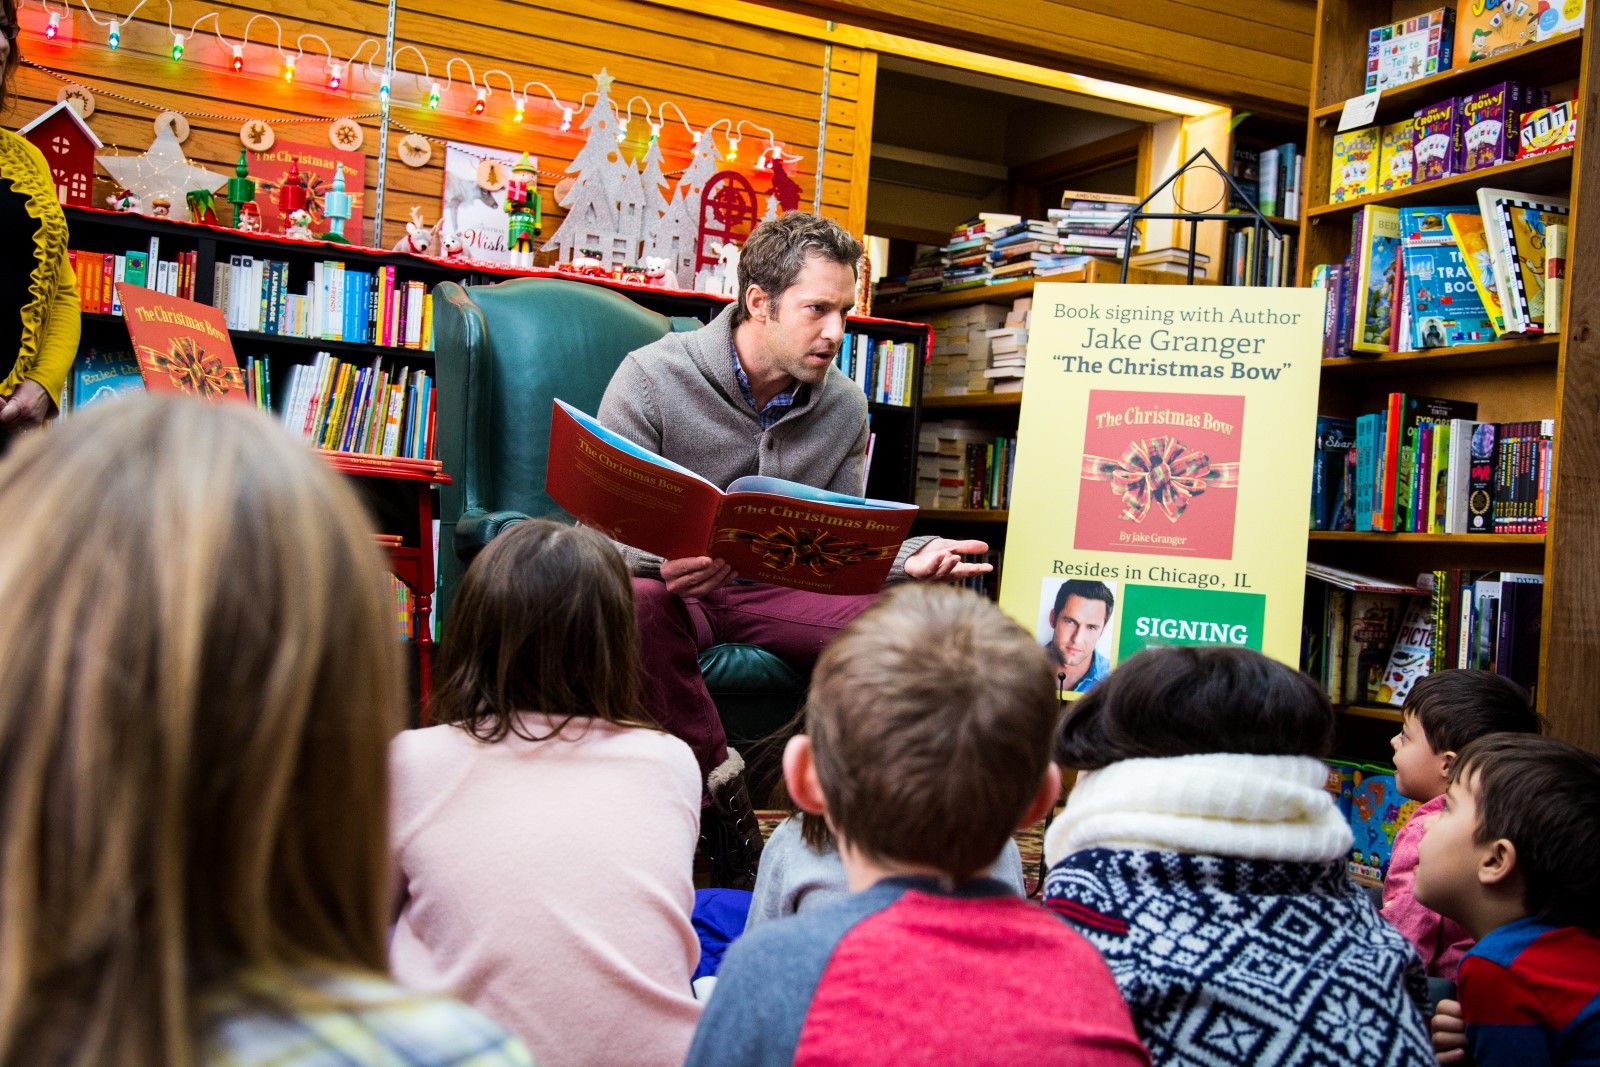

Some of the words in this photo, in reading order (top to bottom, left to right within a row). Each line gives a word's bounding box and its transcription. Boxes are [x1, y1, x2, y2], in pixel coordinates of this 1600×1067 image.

[277, 151, 334, 170] Chistmas
[459, 228, 506, 253] Wish
[1437, 266, 1470, 278] TRA
[270, 270, 278, 322] ALPHABLOCK
[1444, 282, 1476, 293] BOO
[136, 306, 154, 322] The
[154, 306, 205, 332] Christmas
[206, 320, 226, 342] Bow
[1054, 304, 1099, 319] Book
[1105, 305, 1174, 325] signing
[1180, 307, 1223, 322] with
[1229, 309, 1300, 324] Author
[1082, 328, 1141, 350] Jake
[1151, 330, 1265, 358] Granger
[1108, 357, 1225, 379] Christmas
[1096, 412, 1122, 430] The
[1124, 406, 1200, 429] Christmas
[1203, 412, 1234, 436] Bow
[1416, 416, 1451, 426] EXPLORE
[1325, 436, 1356, 448] Shar
[578, 438, 598, 458] The
[598, 450, 656, 487] Christmas
[658, 479, 685, 494] Bow
[734, 504, 768, 516] The
[770, 506, 863, 530] Christmas
[865, 518, 900, 534] Bow
[1119, 531, 1132, 544] By
[1132, 532, 1150, 544] Jake
[1151, 533, 1188, 546] Granger
[1052, 560, 1118, 578] Resides
[1125, 565, 1141, 579] in
[1148, 568, 1226, 588] Chicago,
[1234, 573, 1251, 587] IL
[1135, 617, 1248, 645] SIGNING
[1401, 626, 1430, 647] PICTU
